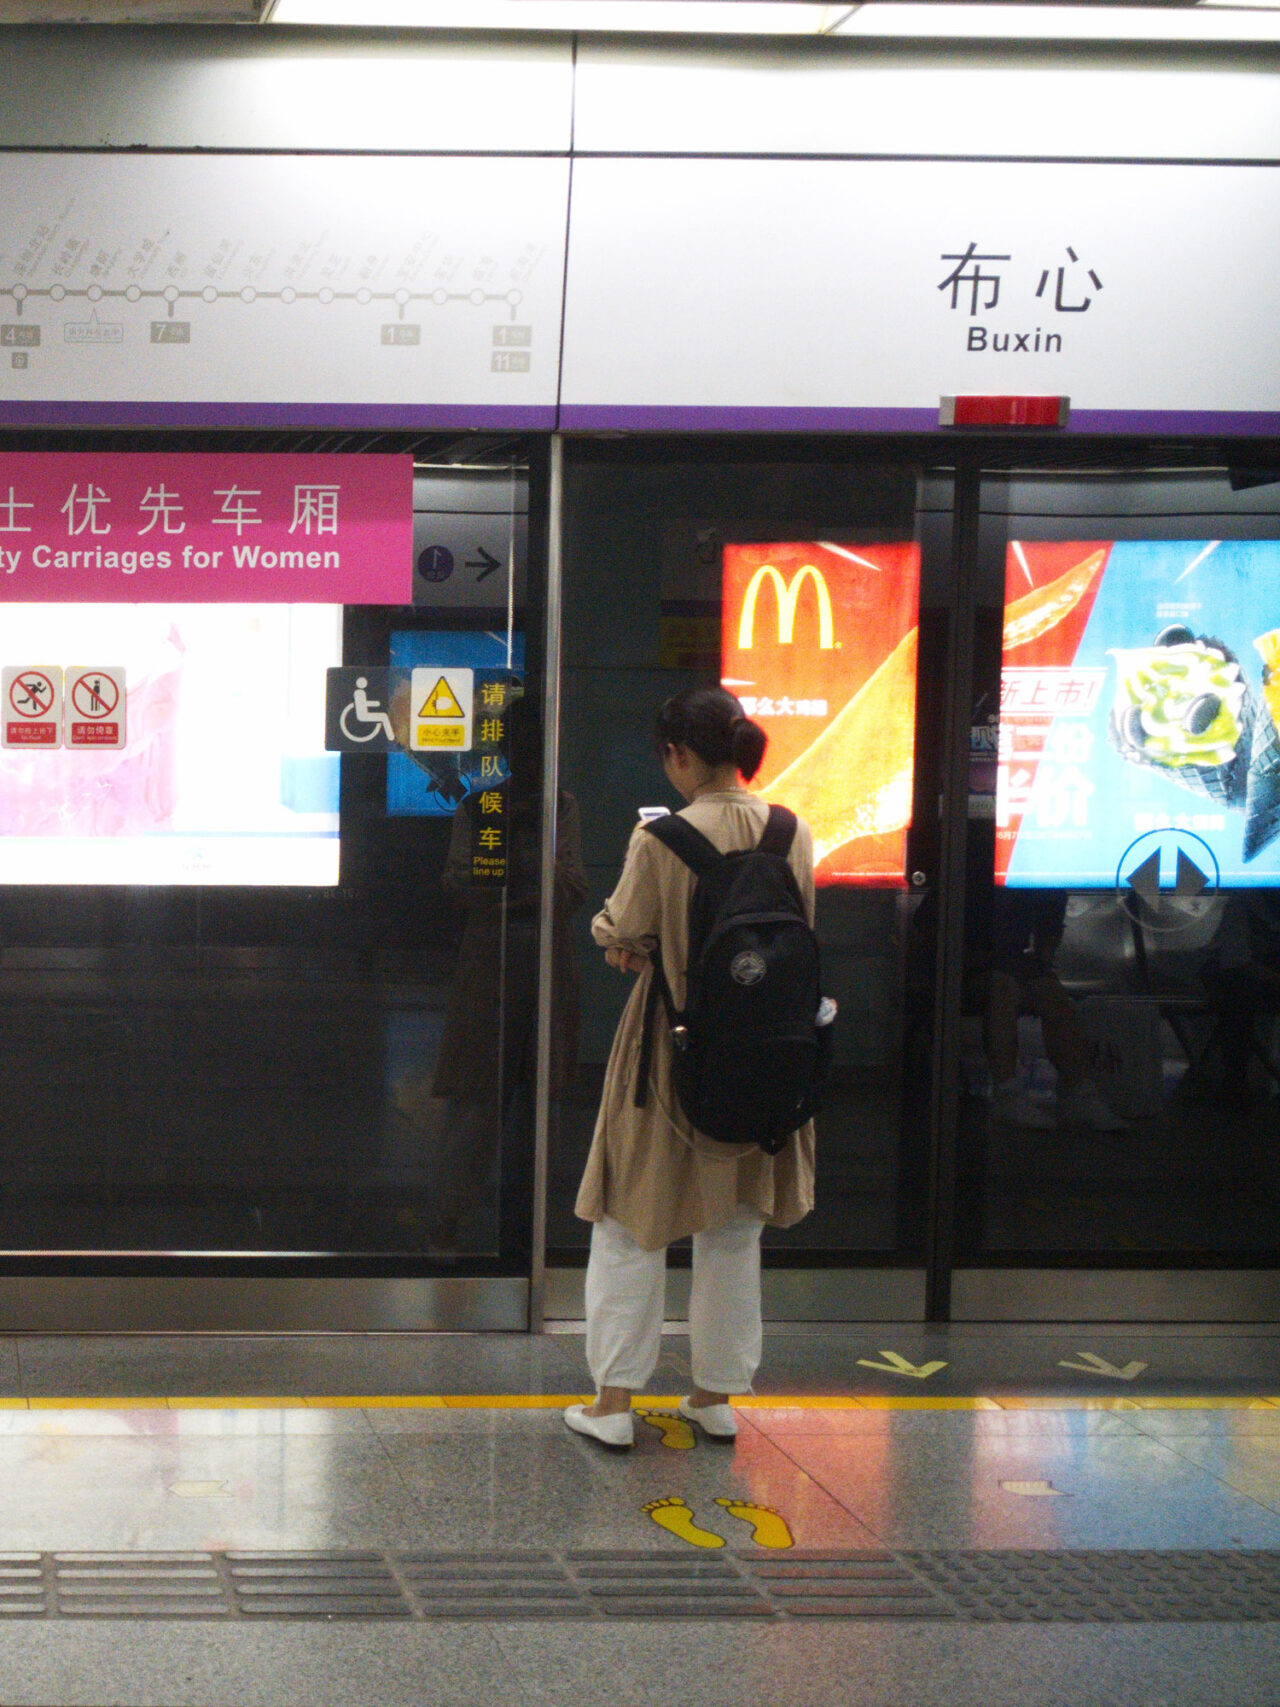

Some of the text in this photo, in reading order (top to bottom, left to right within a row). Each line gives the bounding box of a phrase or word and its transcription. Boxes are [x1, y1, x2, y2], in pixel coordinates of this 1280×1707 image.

[936, 241, 1104, 317] 布心
[966, 326, 1063, 354] Buxin
[31, 544, 173, 574] Carriages
[182, 546, 223, 570] for
[233, 546, 341, 570] Women
[478, 682, 506, 851] 请排队候车
[472, 866, 506, 879] line up
[473, 855, 506, 867] Please
